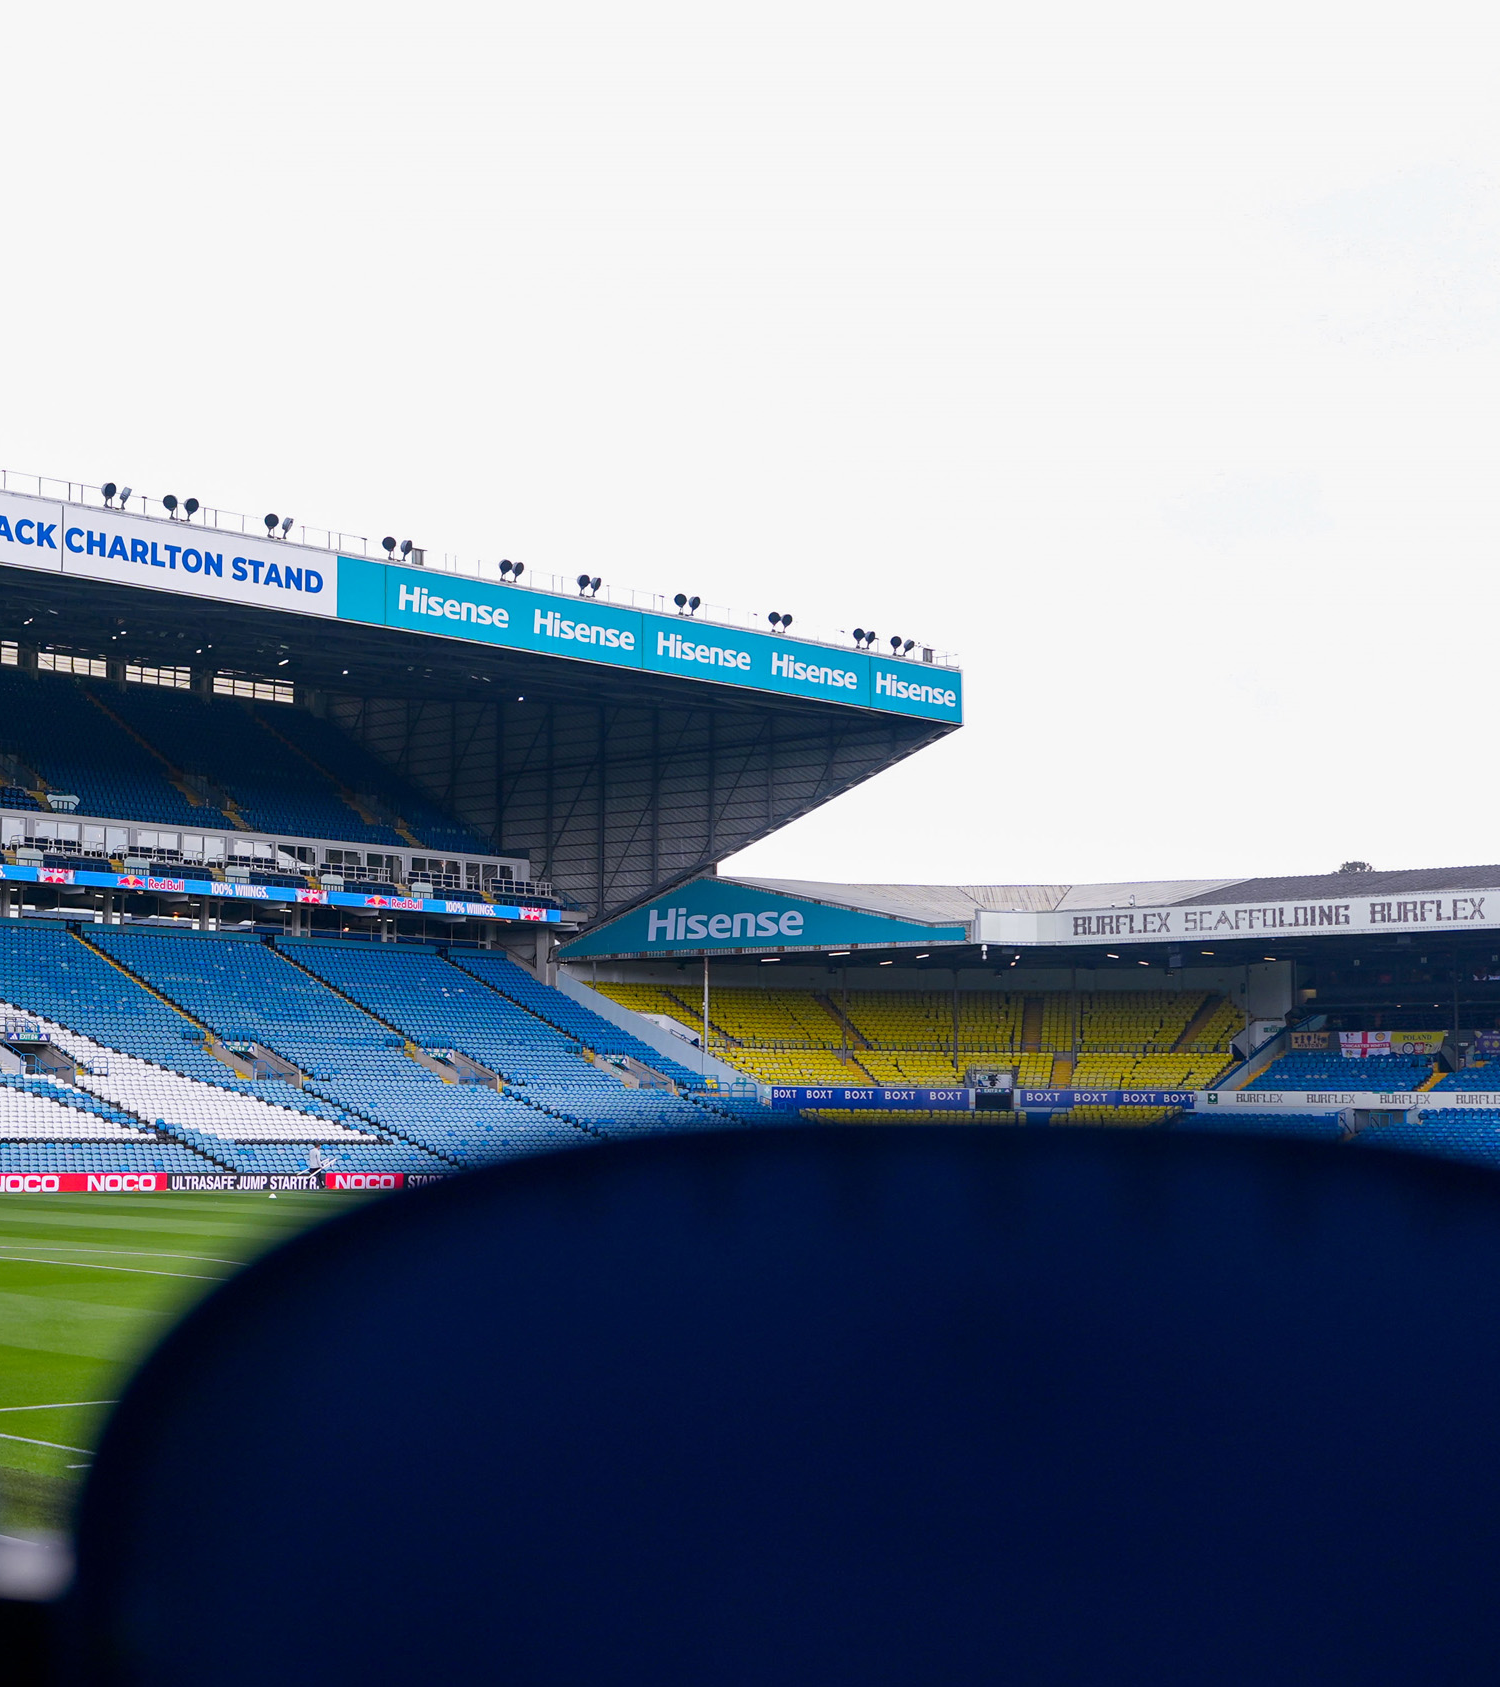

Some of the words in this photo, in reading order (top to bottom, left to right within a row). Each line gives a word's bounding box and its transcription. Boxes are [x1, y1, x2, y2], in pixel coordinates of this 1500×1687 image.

[65, 527, 222, 578] CHARLTON
[232, 556, 324, 594] STAND
[397, 584, 509, 629] Hisense
[533, 608, 636, 651] Hisense
[656, 632, 751, 672] Hisense
[770, 652, 858, 690] Hisense
[875, 672, 956, 708] Hisense
[148, 878, 166, 890] Red
[167, 880, 184, 891] Bull
[211, 882, 233, 896] 100%
[391, 899, 407, 909] Red
[407, 899, 423, 910] Bull
[446, 901, 465, 914] 100%
[1369, 897, 1485, 924] BURFLEX
[646, 907, 805, 943] Hisense
[1073, 912, 1171, 936] BURFLEX
[1184, 905, 1350, 931] SCAFFOLDING
[773, 1089, 797, 1099] BOXT
[806, 1090, 833, 1100] BOXT
[845, 1090, 874, 1100] BOXT
[884, 1091, 916, 1101] BOXT
[929, 1091, 962, 1101] BOXT
[1026, 1092, 1060, 1102] BOXT
[1073, 1093, 1108, 1102] BOXT
[1123, 1093, 1156, 1103] BOXT
[1163, 1094, 1194, 1103] BOXT
[1236, 1093, 1283, 1104] BURFLEX
[1306, 1093, 1355, 1104] BURFLEX
[1380, 1094, 1430, 1105] BURFLEX
[1456, 1094, 1500, 1105] BURFLE
[87, 1175, 156, 1192] NOCO
[237, 1176, 268, 1190] JUMP
[335, 1174, 395, 1190] NOCO
